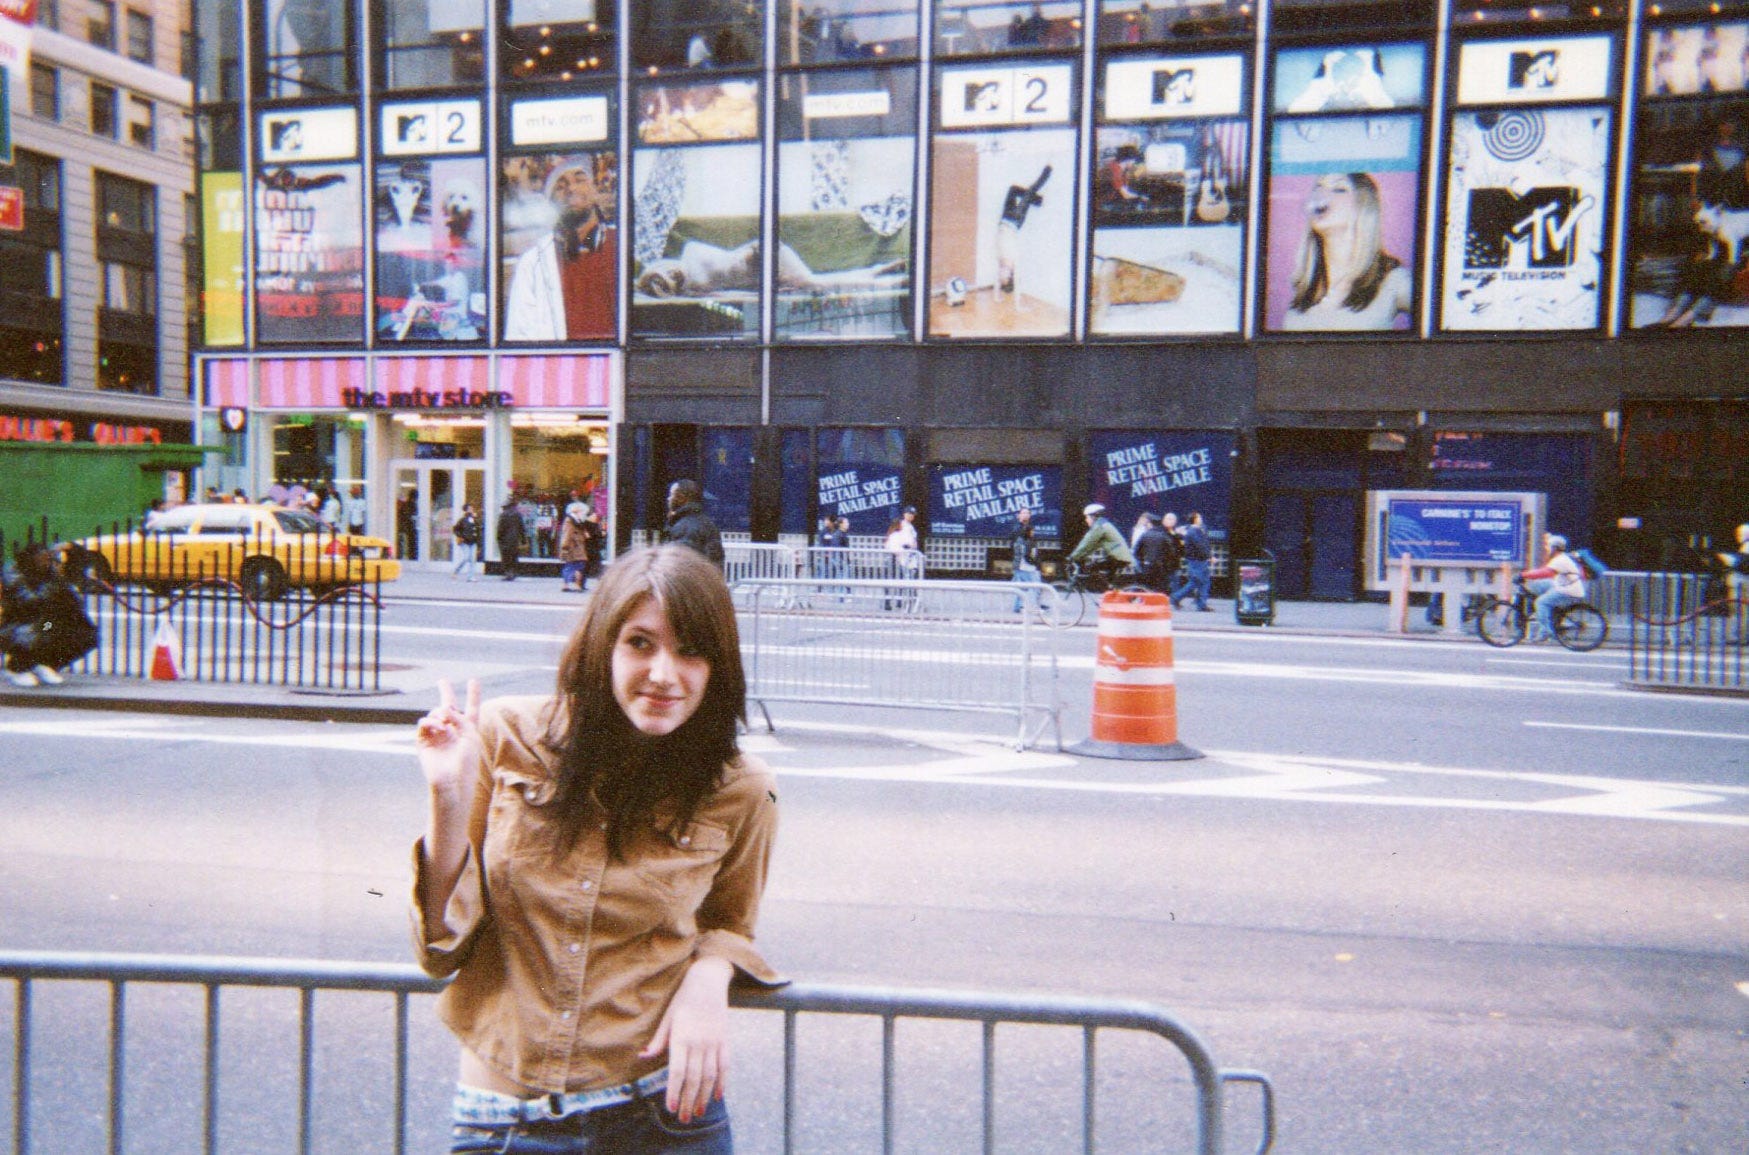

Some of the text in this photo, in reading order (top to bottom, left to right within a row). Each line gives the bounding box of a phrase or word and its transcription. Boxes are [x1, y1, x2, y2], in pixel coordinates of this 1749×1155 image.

[1024, 77, 1048, 113] 2
[447, 112, 465, 143] 2
[525, 114, 593, 127] mtv.com
[1463, 186, 1596, 269] MTV
[1502, 271, 1566, 280] TELEVISION
[342, 386, 514, 408] the mtv store
[1107, 443, 1158, 468] PRIME
[1107, 448, 1212, 485] RETAIL SPACE
[819, 470, 859, 490] PRIME
[819, 476, 900, 505] RETAIL SPACE
[943, 467, 992, 491] PRIME
[943, 474, 1044, 508] RETAIL SPACE
[1132, 466, 1213, 498] AVAILABLE
[837, 491, 900, 515] AVAILABLE
[966, 492, 1044, 521] AVAILABLE
